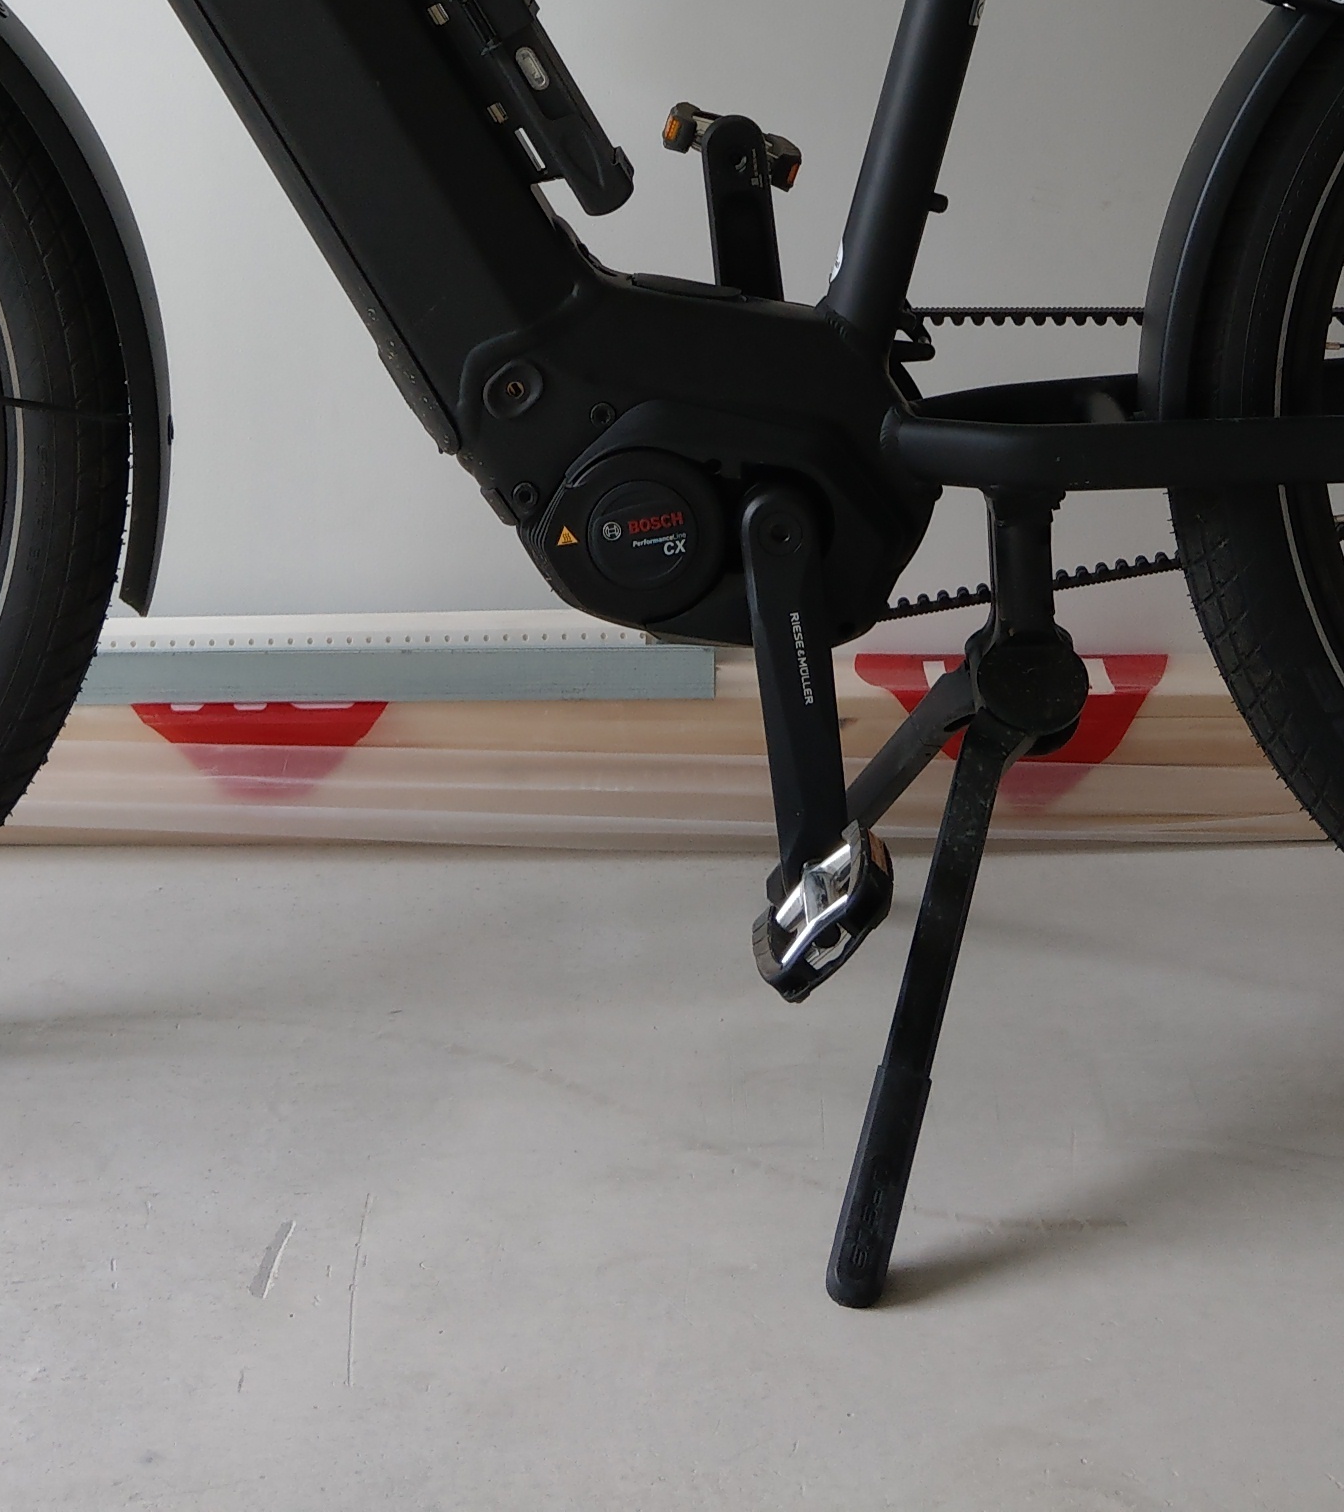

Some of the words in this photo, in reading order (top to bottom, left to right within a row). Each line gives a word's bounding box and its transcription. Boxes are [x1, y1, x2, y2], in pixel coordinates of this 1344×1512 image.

[628, 511, 684, 534] BOSCH
[663, 538, 686, 556] CX
[790, 612, 804, 649] RIESE
